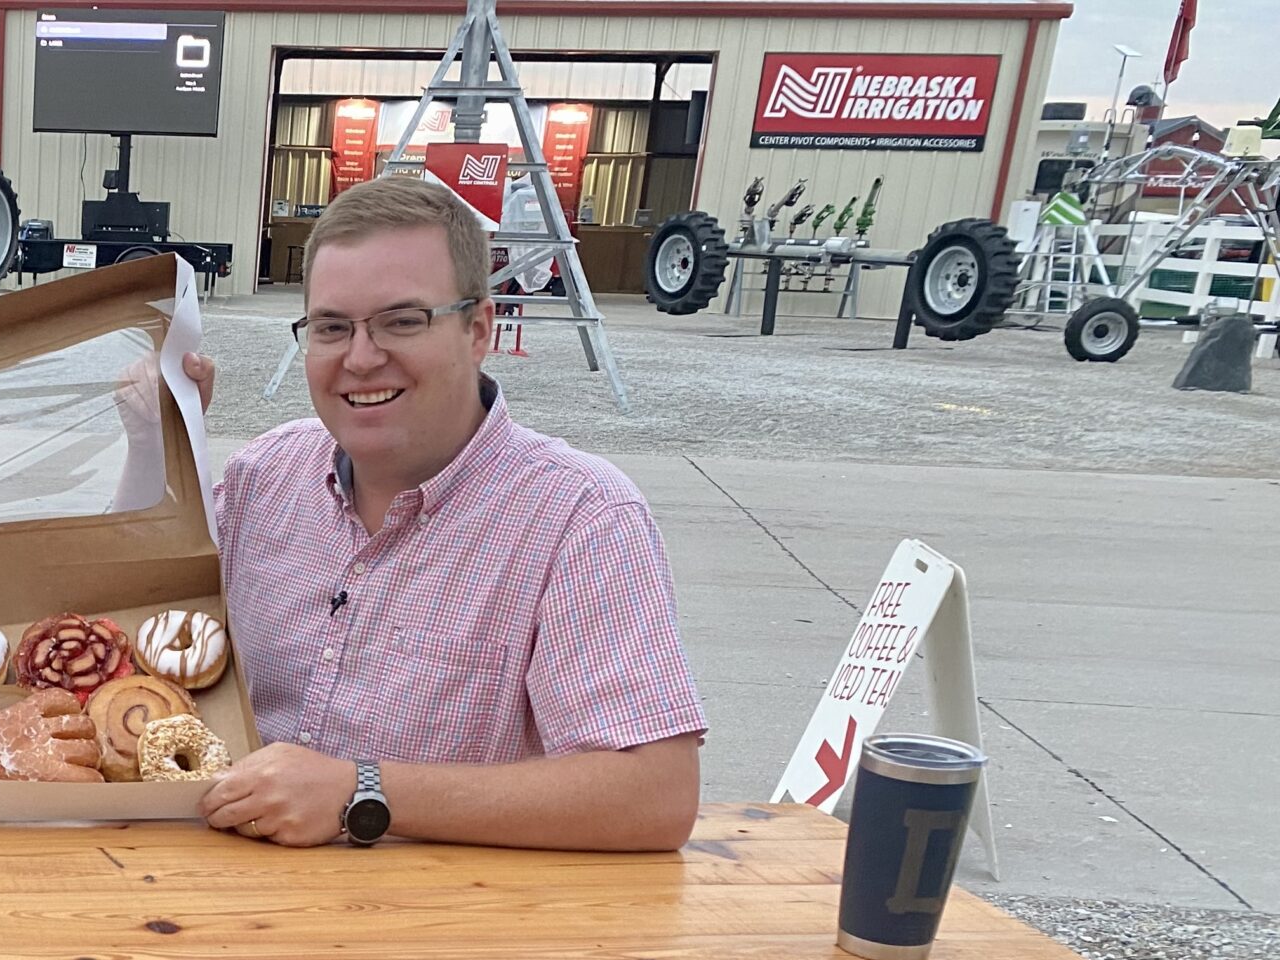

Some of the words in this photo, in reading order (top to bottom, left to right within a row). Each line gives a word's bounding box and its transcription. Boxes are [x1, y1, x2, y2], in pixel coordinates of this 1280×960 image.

[849, 75, 977, 99] NEBRASKA
[840, 97, 985, 122] IRRIGATION
[759, 135, 790, 146] CENTER
[789, 135, 815, 146] PIVOT
[815, 136, 871, 147] COMPONENTS
[876, 137, 922, 147] IRRIGATION
[922, 138, 977, 148] ACCESSORIES
[867, 581, 911, 619] FREE
[848, 622, 906, 662] COFFEE
[897, 625, 918, 664] &
[829, 663, 866, 701] ICED
[860, 667, 901, 708] TEA!
